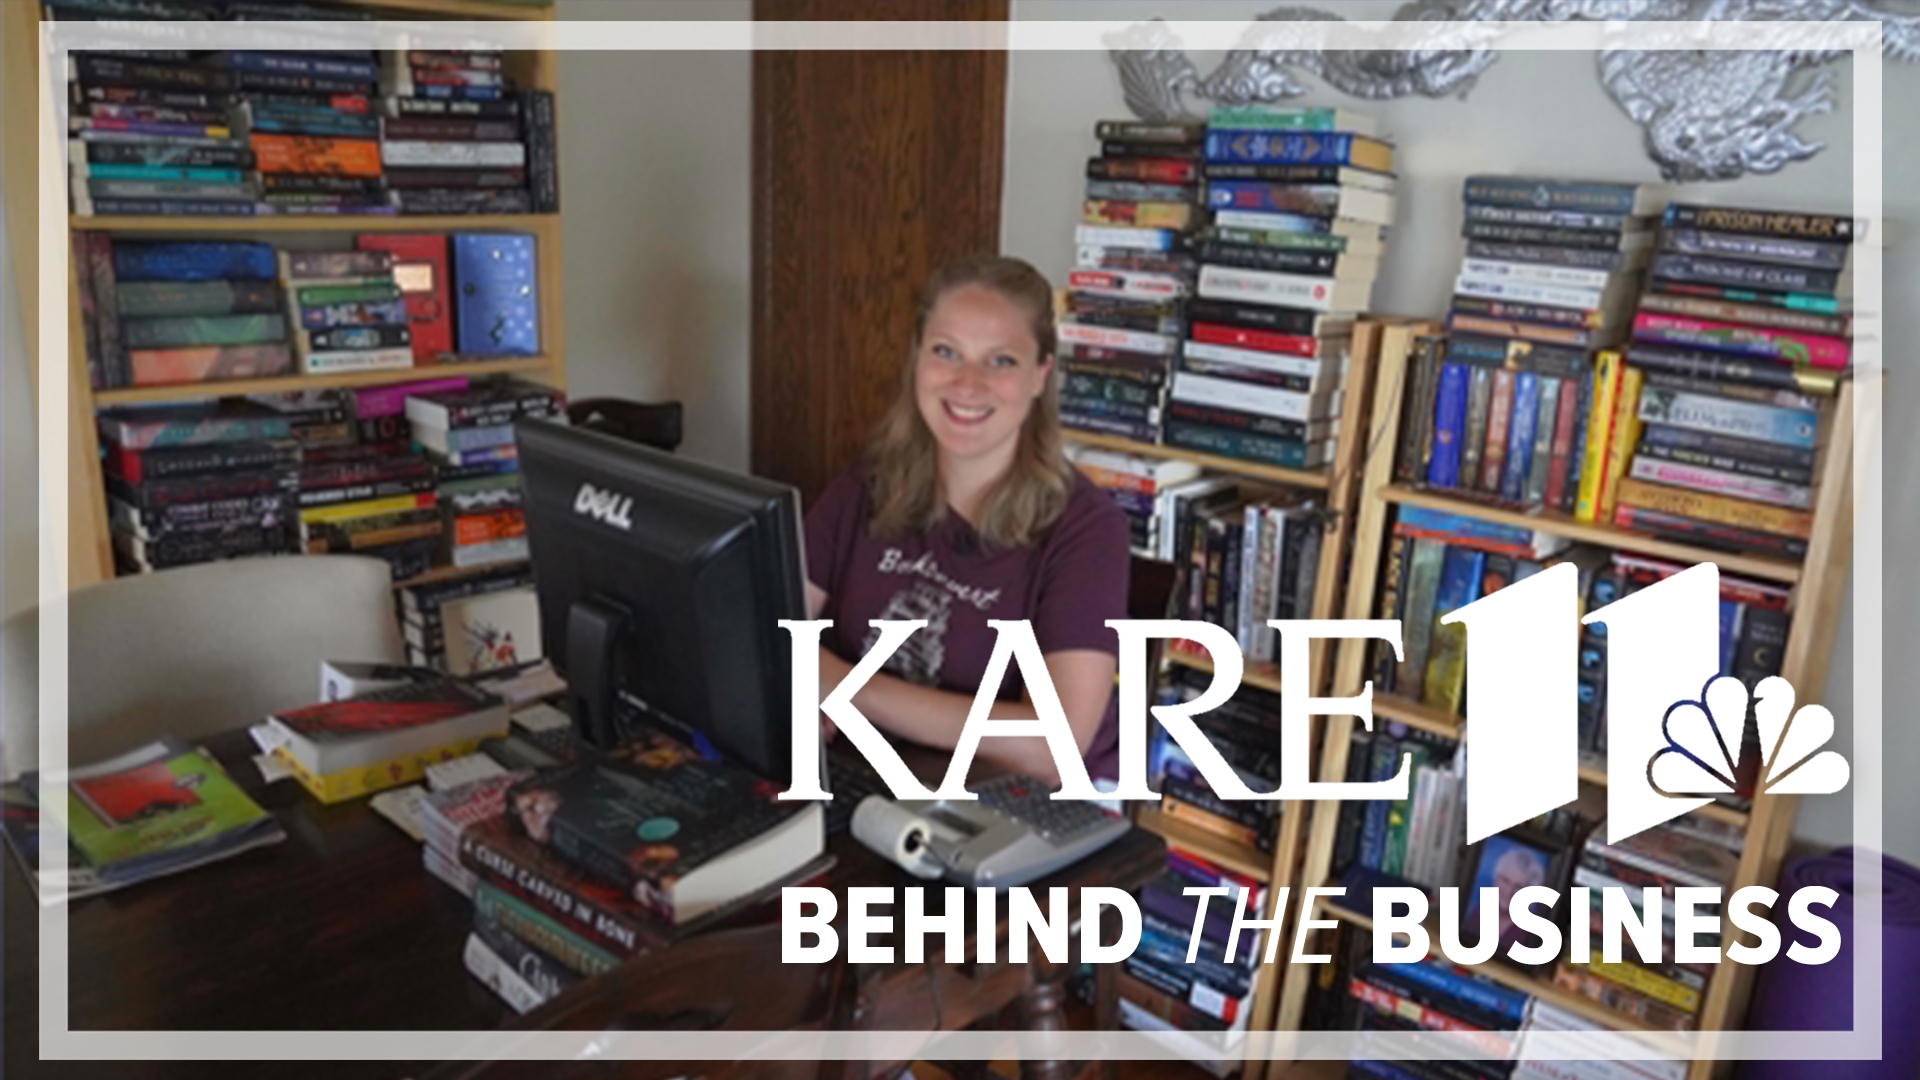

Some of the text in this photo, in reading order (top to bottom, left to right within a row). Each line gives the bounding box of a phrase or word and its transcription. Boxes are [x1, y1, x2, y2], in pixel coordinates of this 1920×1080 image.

[574, 482, 634, 531] DELL
[475, 845, 516, 879] CURSE
[517, 870, 572, 912] CARVED
[574, 901, 593, 925] IN
[595, 914, 637, 949] BONE
